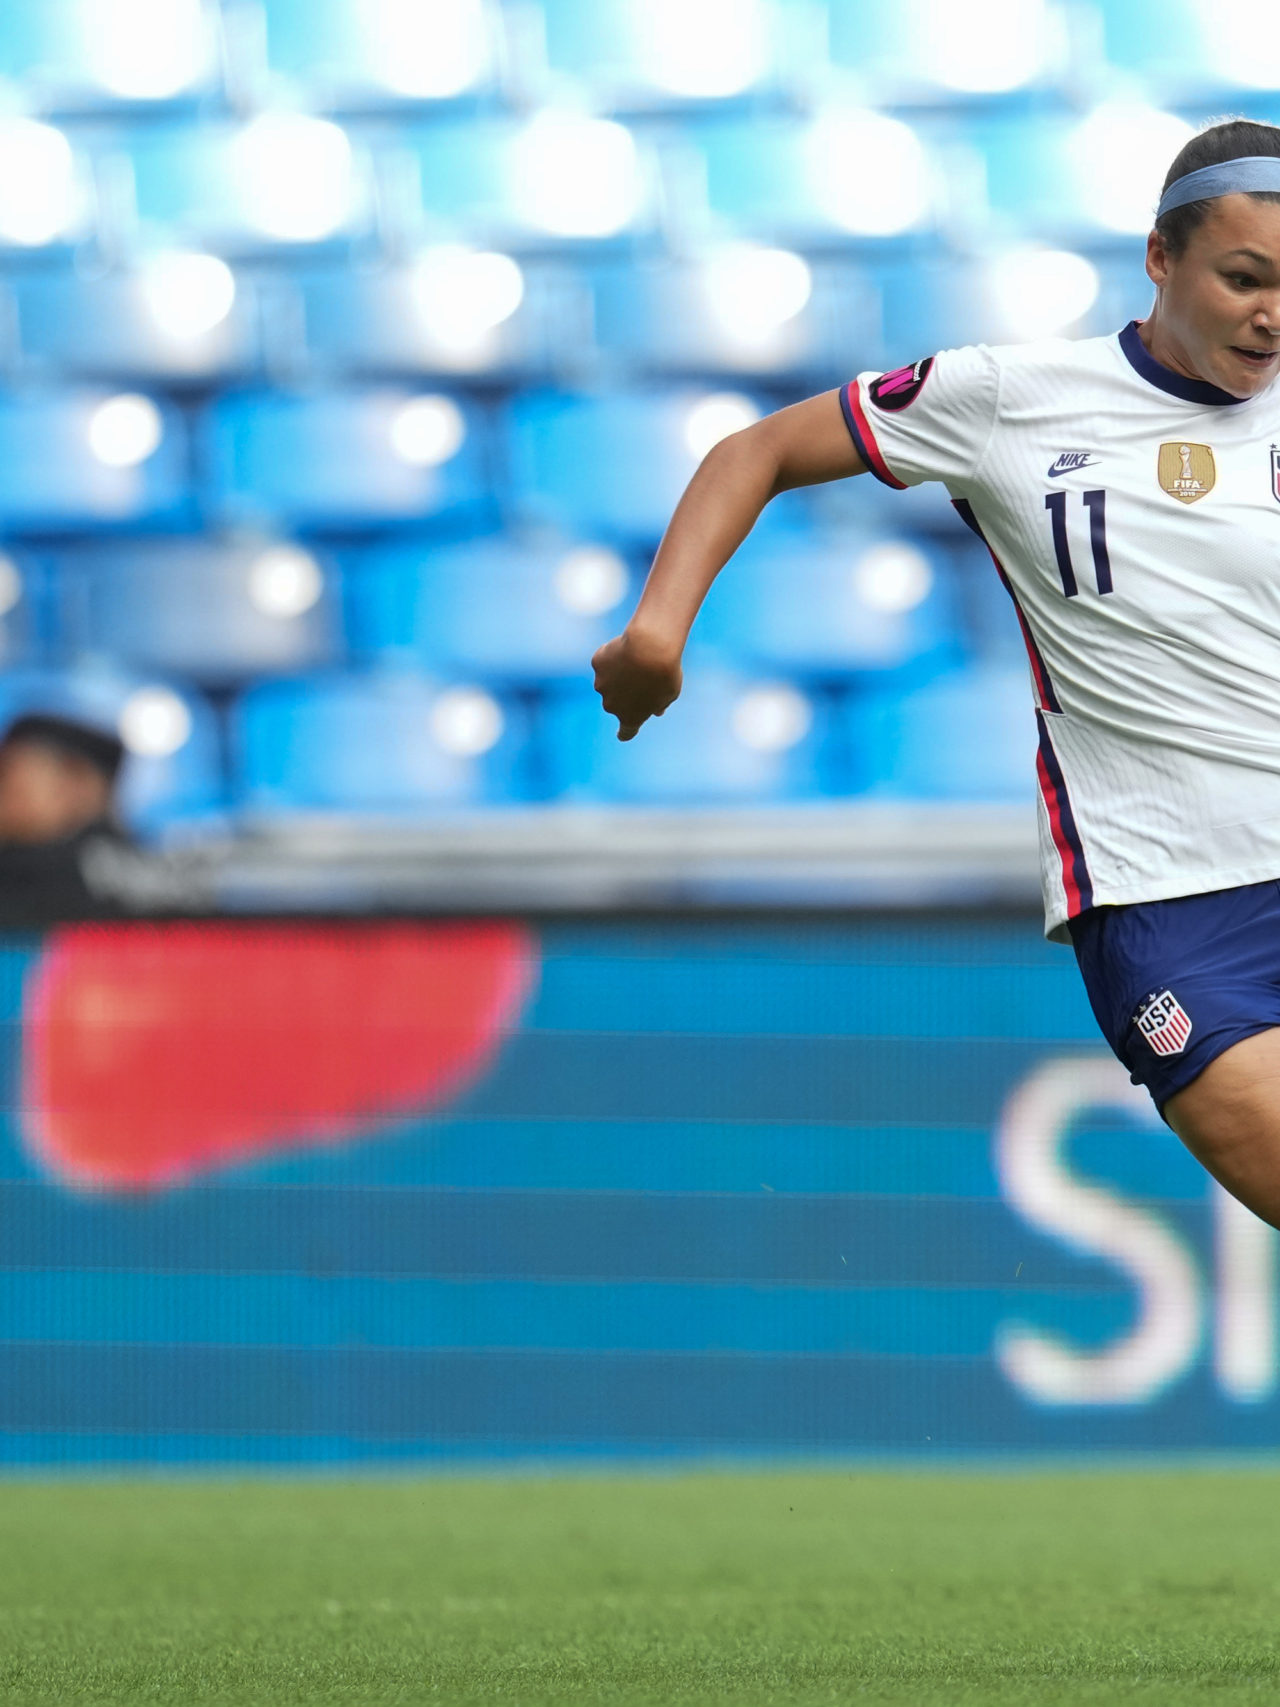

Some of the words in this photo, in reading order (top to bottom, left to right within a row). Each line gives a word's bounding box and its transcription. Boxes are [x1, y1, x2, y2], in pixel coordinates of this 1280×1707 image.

[1056, 453, 1091, 467] NIKE
[1173, 479, 1201, 489] FIFA
[1045, 489, 1114, 598] 11
[1141, 994, 1176, 1034] USA
